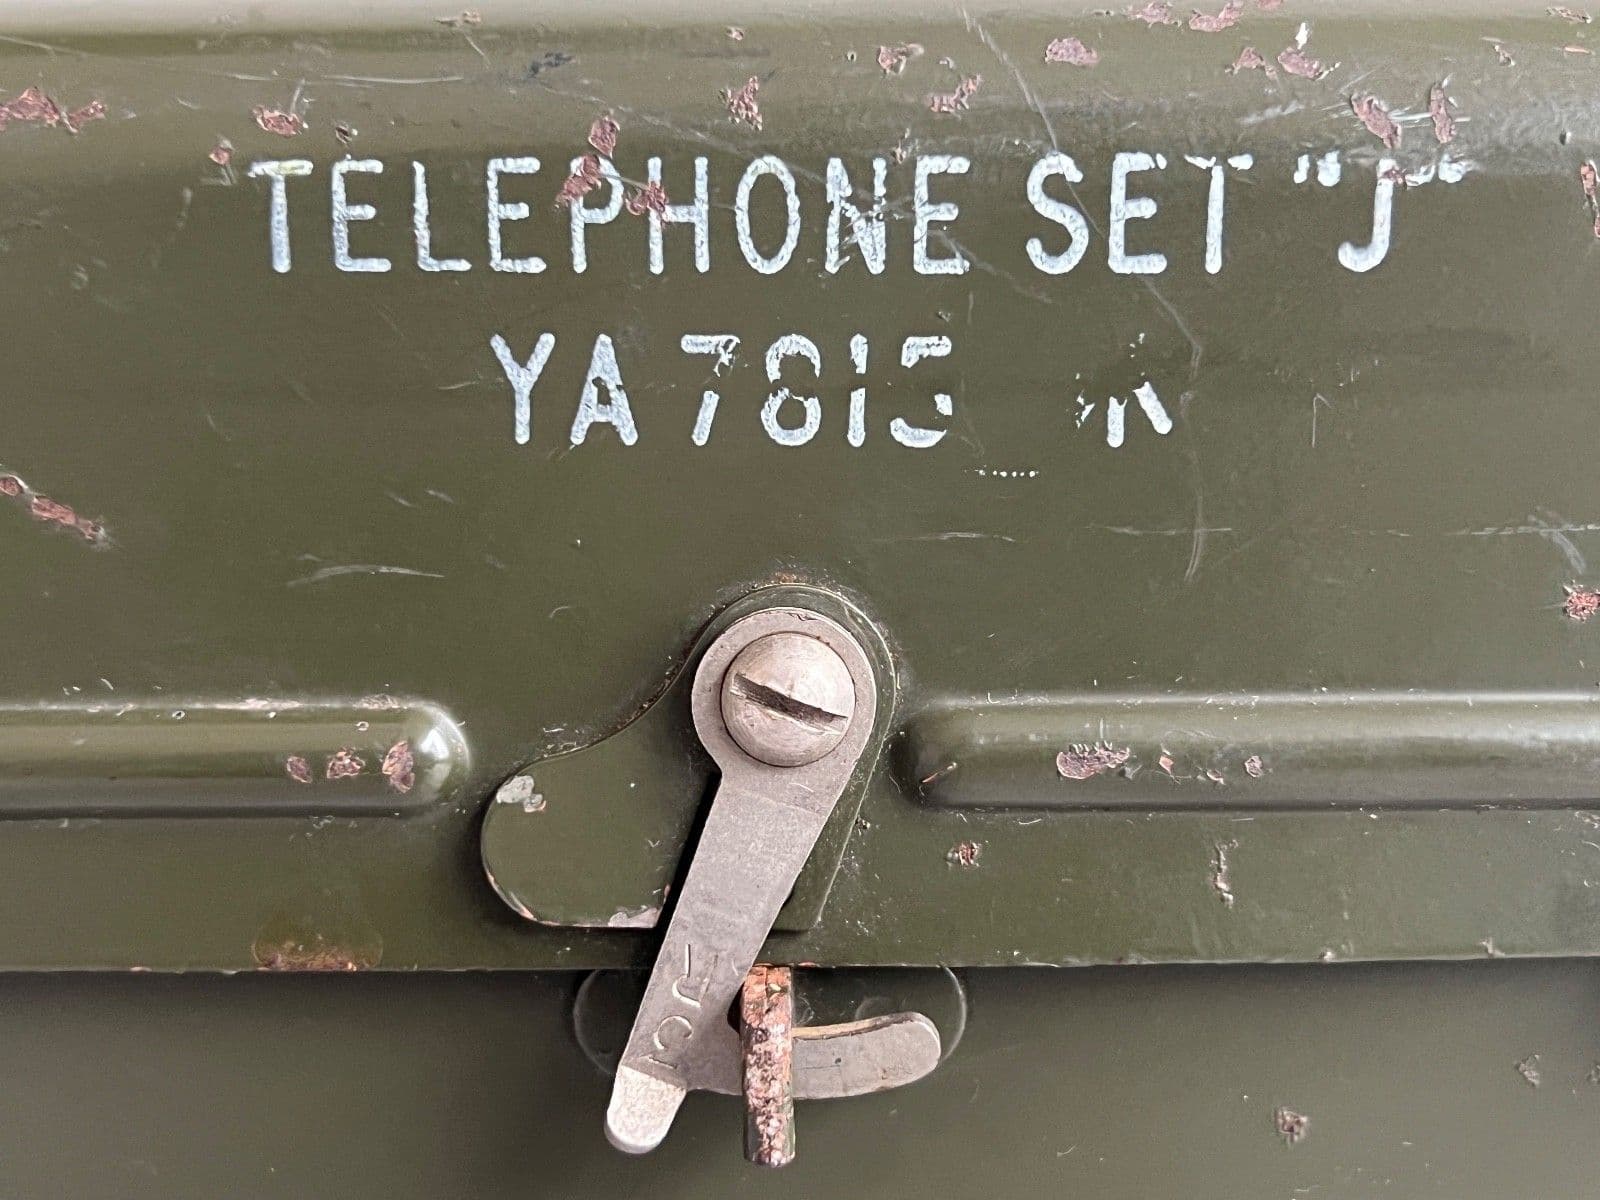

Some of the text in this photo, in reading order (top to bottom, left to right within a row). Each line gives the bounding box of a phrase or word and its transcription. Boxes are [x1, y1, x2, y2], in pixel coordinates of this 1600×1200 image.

[248, 154, 970, 275] TELEPHONE
[1025, 151, 1254, 275] SET
[489, 332, 639, 446] YA
